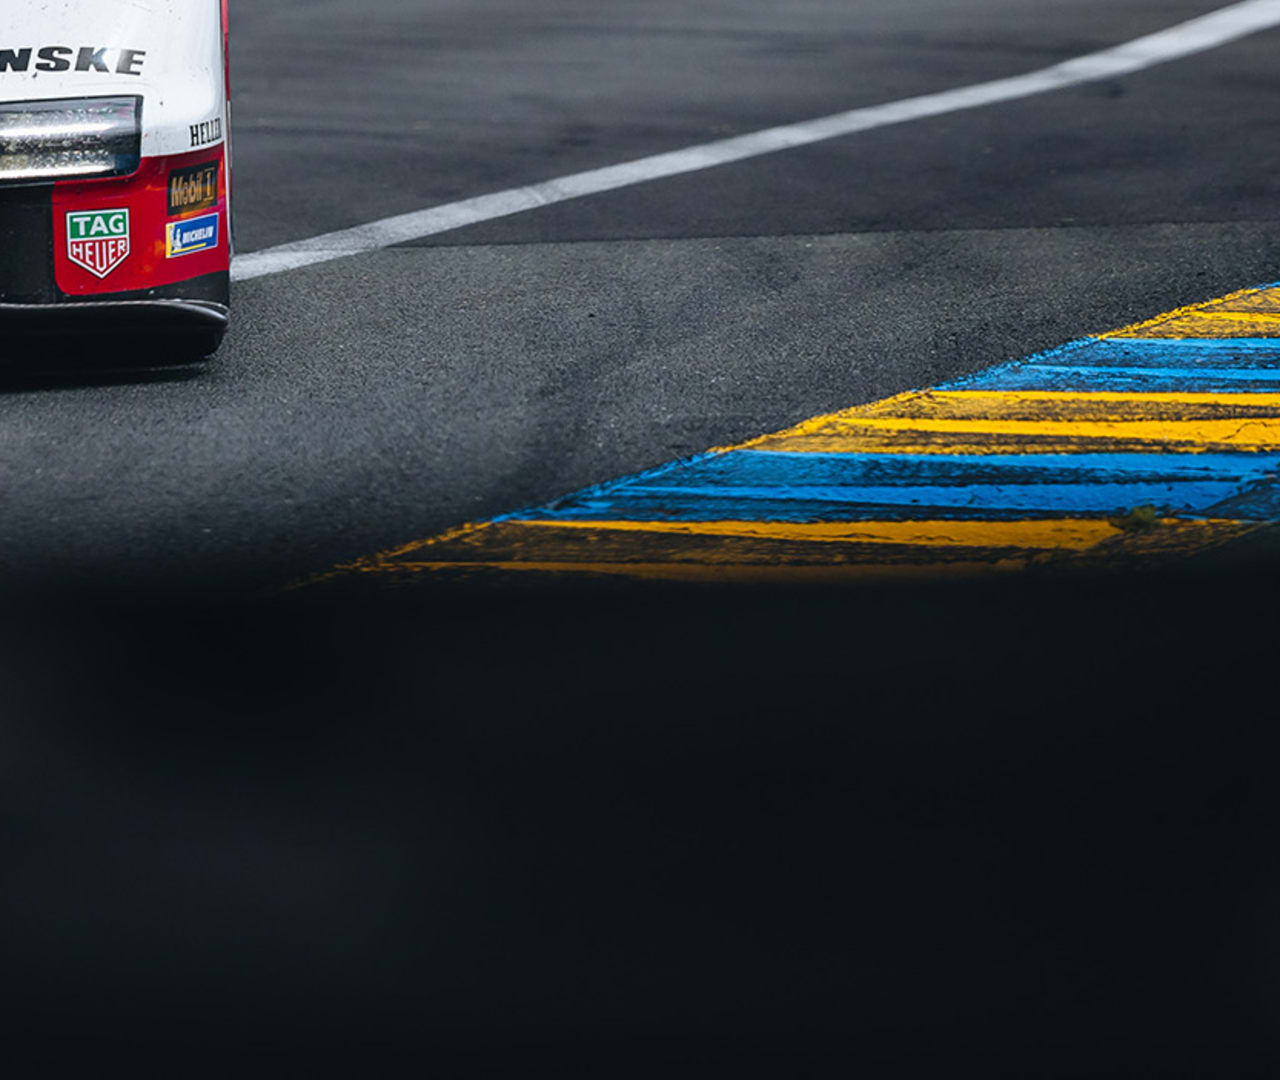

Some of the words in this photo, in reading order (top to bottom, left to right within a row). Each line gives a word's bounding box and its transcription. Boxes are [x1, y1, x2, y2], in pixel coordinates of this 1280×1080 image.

[171, 172, 203, 207] Mobil
[73, 216, 124, 235] TAG
[72, 239, 126, 272] HEUER
